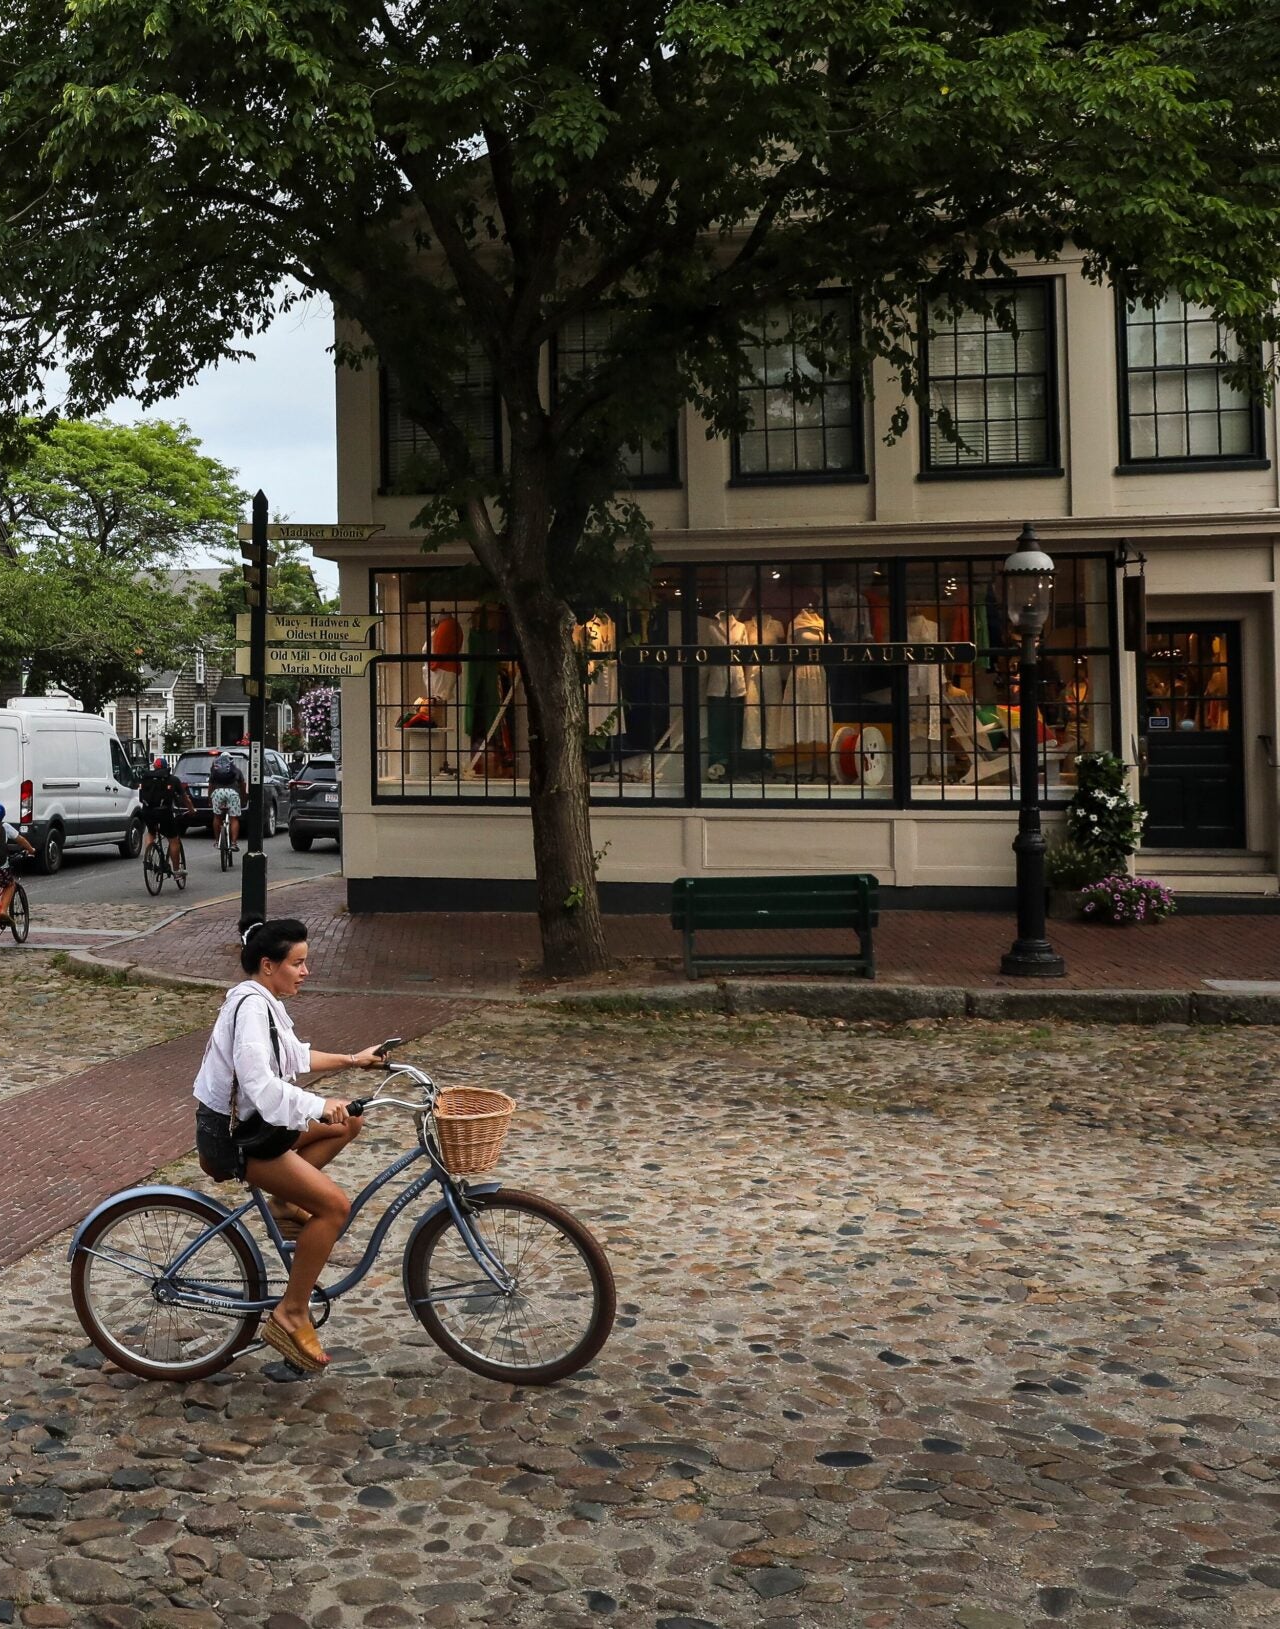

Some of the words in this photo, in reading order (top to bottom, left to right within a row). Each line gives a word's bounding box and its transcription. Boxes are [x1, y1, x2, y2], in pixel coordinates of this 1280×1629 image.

[280, 528, 325, 538] Madaket
[331, 528, 364, 538] Dionis
[275, 617, 300, 629] Macy
[310, 617, 349, 628] Hadwen
[352, 617, 361, 628] &
[286, 629, 317, 640] Oldest
[320, 630, 349, 640] House
[270, 650, 287, 661] Old
[290, 651, 310, 662] Mill
[319, 651, 336, 661] Old
[340, 651, 363, 662] Gaol
[639, 649, 708, 663] POLO
[730, 648, 820, 663] RALPH
[842, 646, 956, 661] LAUREN
[281, 663, 309, 674] Maria
[312, 664, 352, 675] Mitchell
[391, 1177, 427, 1214] NANTUCKET
[204, 1299, 234, 1308] PRIORITY
